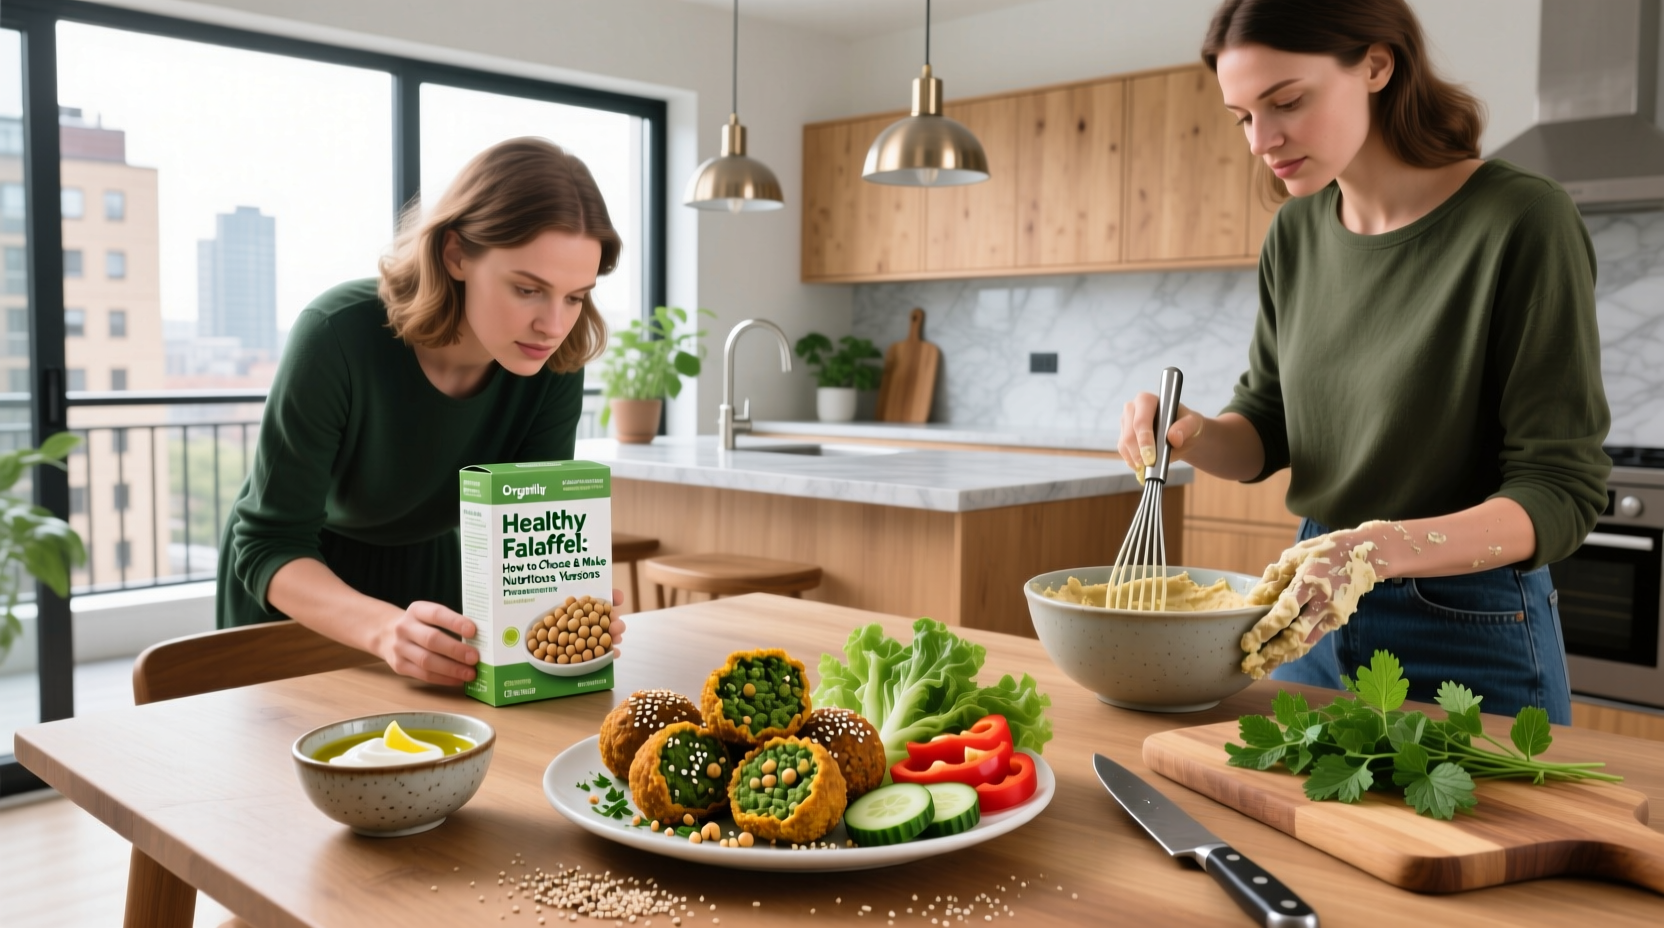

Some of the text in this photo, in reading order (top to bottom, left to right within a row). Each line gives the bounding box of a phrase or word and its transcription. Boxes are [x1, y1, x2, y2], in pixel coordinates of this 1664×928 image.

[502, 509, 587, 534] Healthy
[502, 563, 524, 574] How
[526, 563, 537, 571] to
